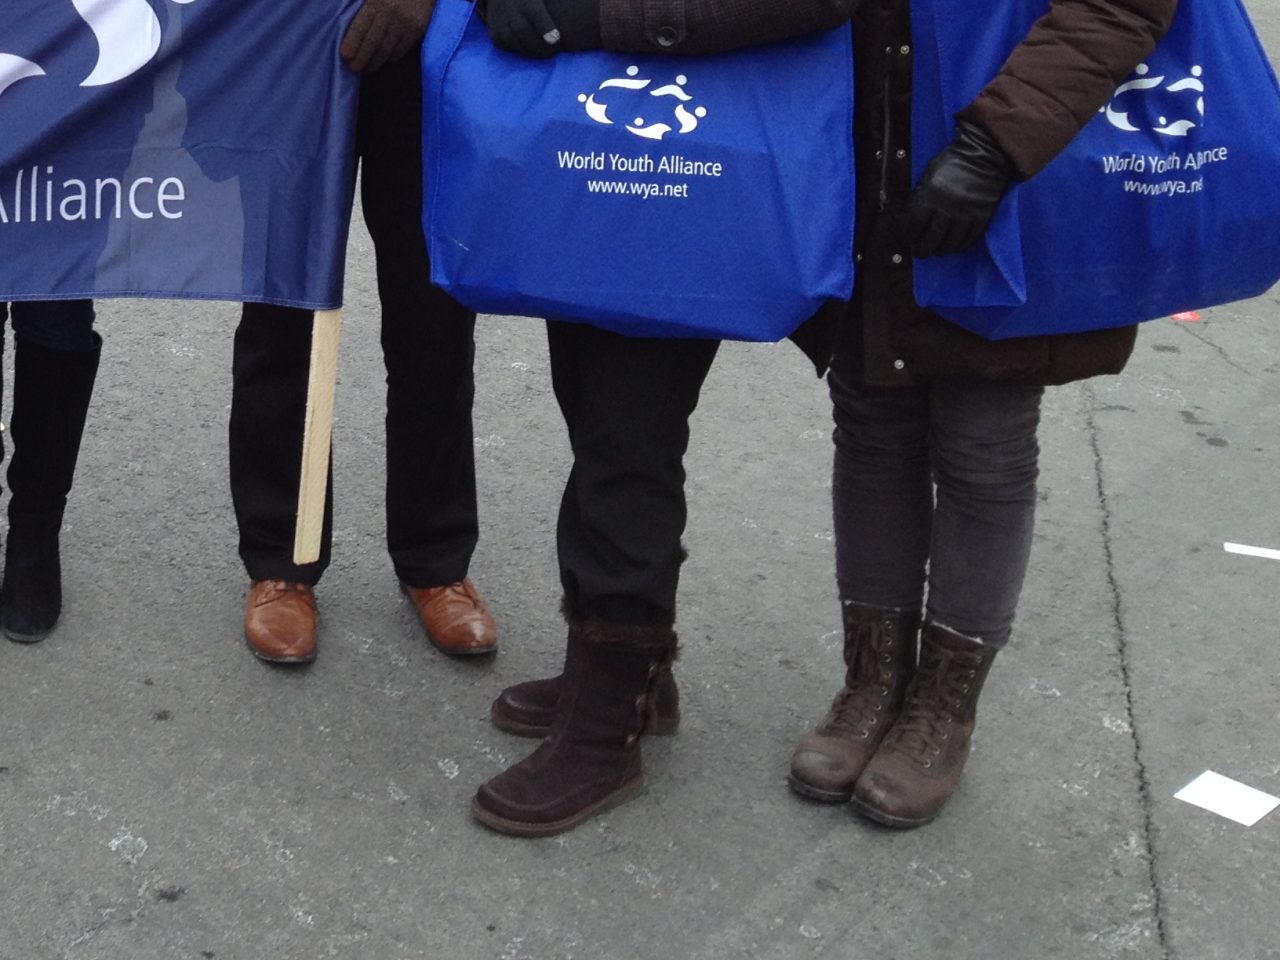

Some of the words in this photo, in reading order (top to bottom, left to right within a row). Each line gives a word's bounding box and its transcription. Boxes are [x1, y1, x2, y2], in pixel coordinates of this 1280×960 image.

[557, 151, 605, 170] World
[609, 153, 654, 172] Youth
[657, 155, 723, 176] Alliance
[1102, 154, 1145, 174] World
[587, 180, 689, 199] www.wya.net
